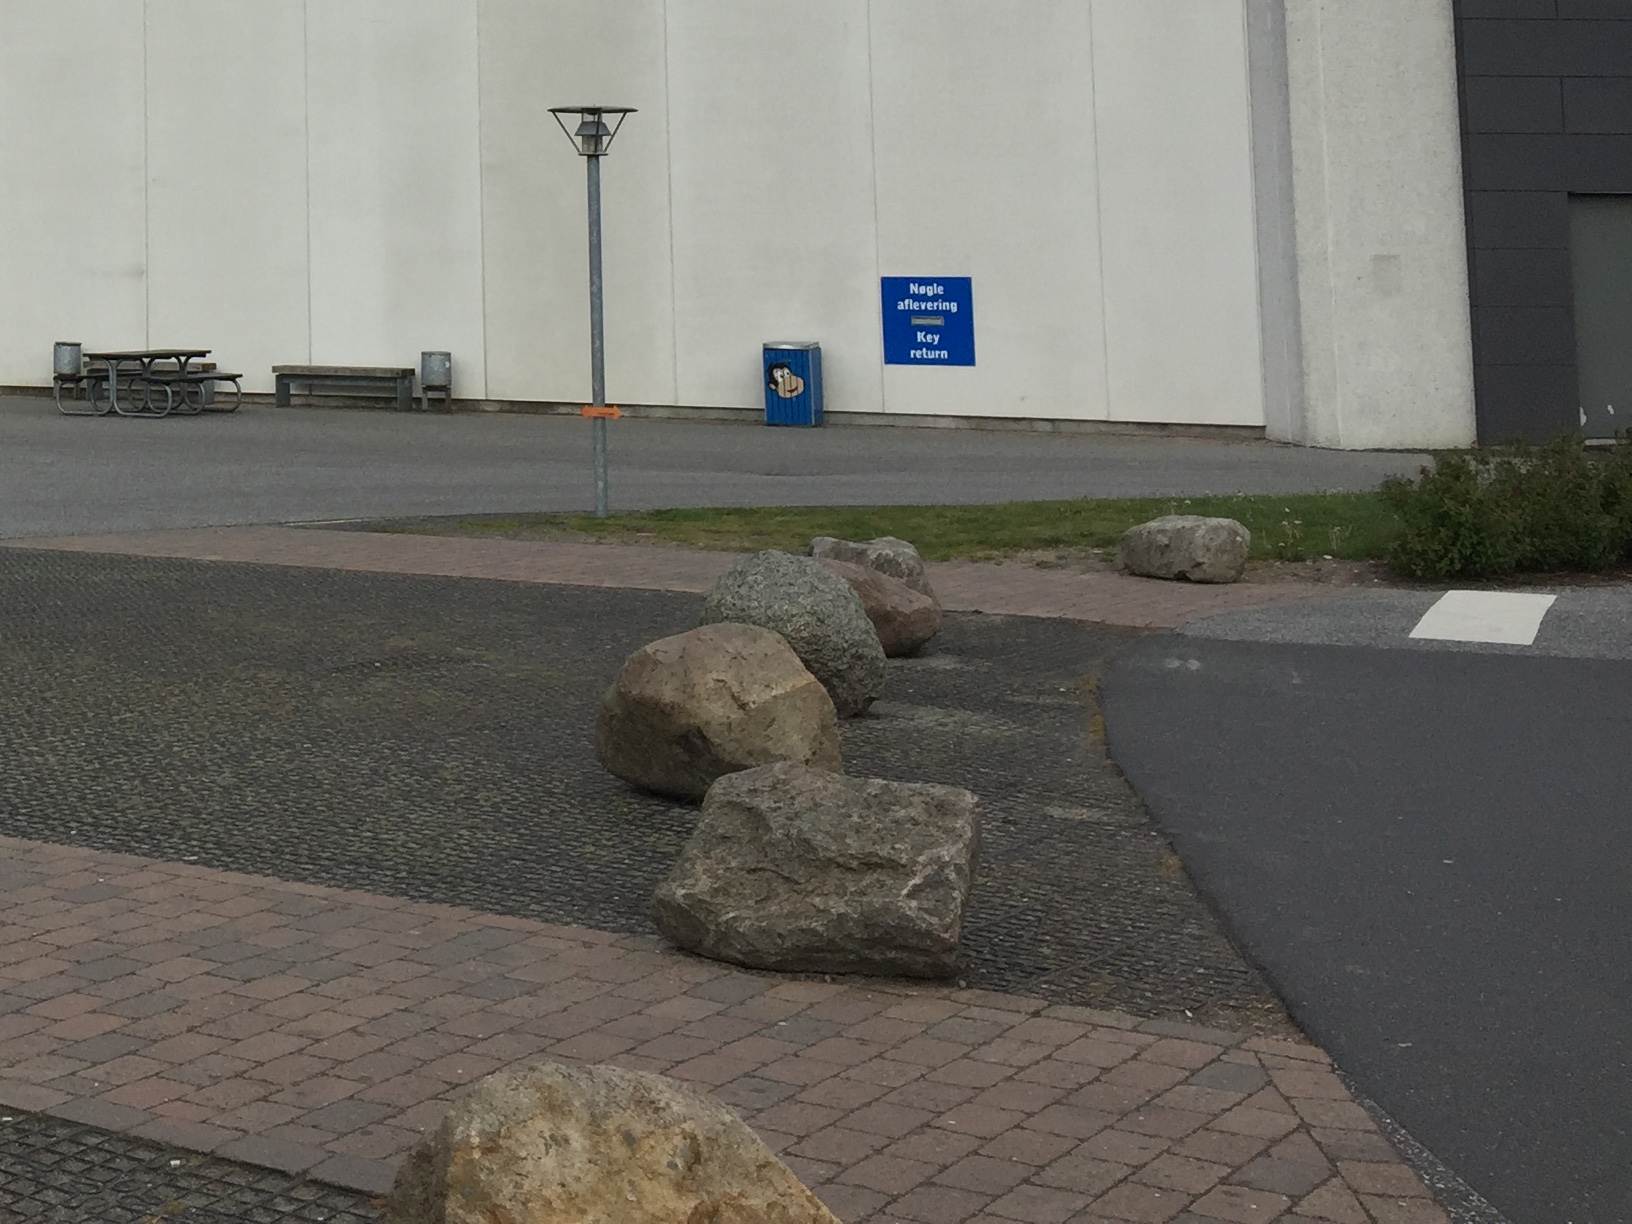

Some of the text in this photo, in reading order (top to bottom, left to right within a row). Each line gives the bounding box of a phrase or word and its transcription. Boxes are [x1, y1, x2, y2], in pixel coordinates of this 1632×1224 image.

[909, 282, 944, 297] Nøgle
[896, 298, 958, 313] aflevering
[916, 331, 940, 345] Key
[910, 347, 948, 359] return
